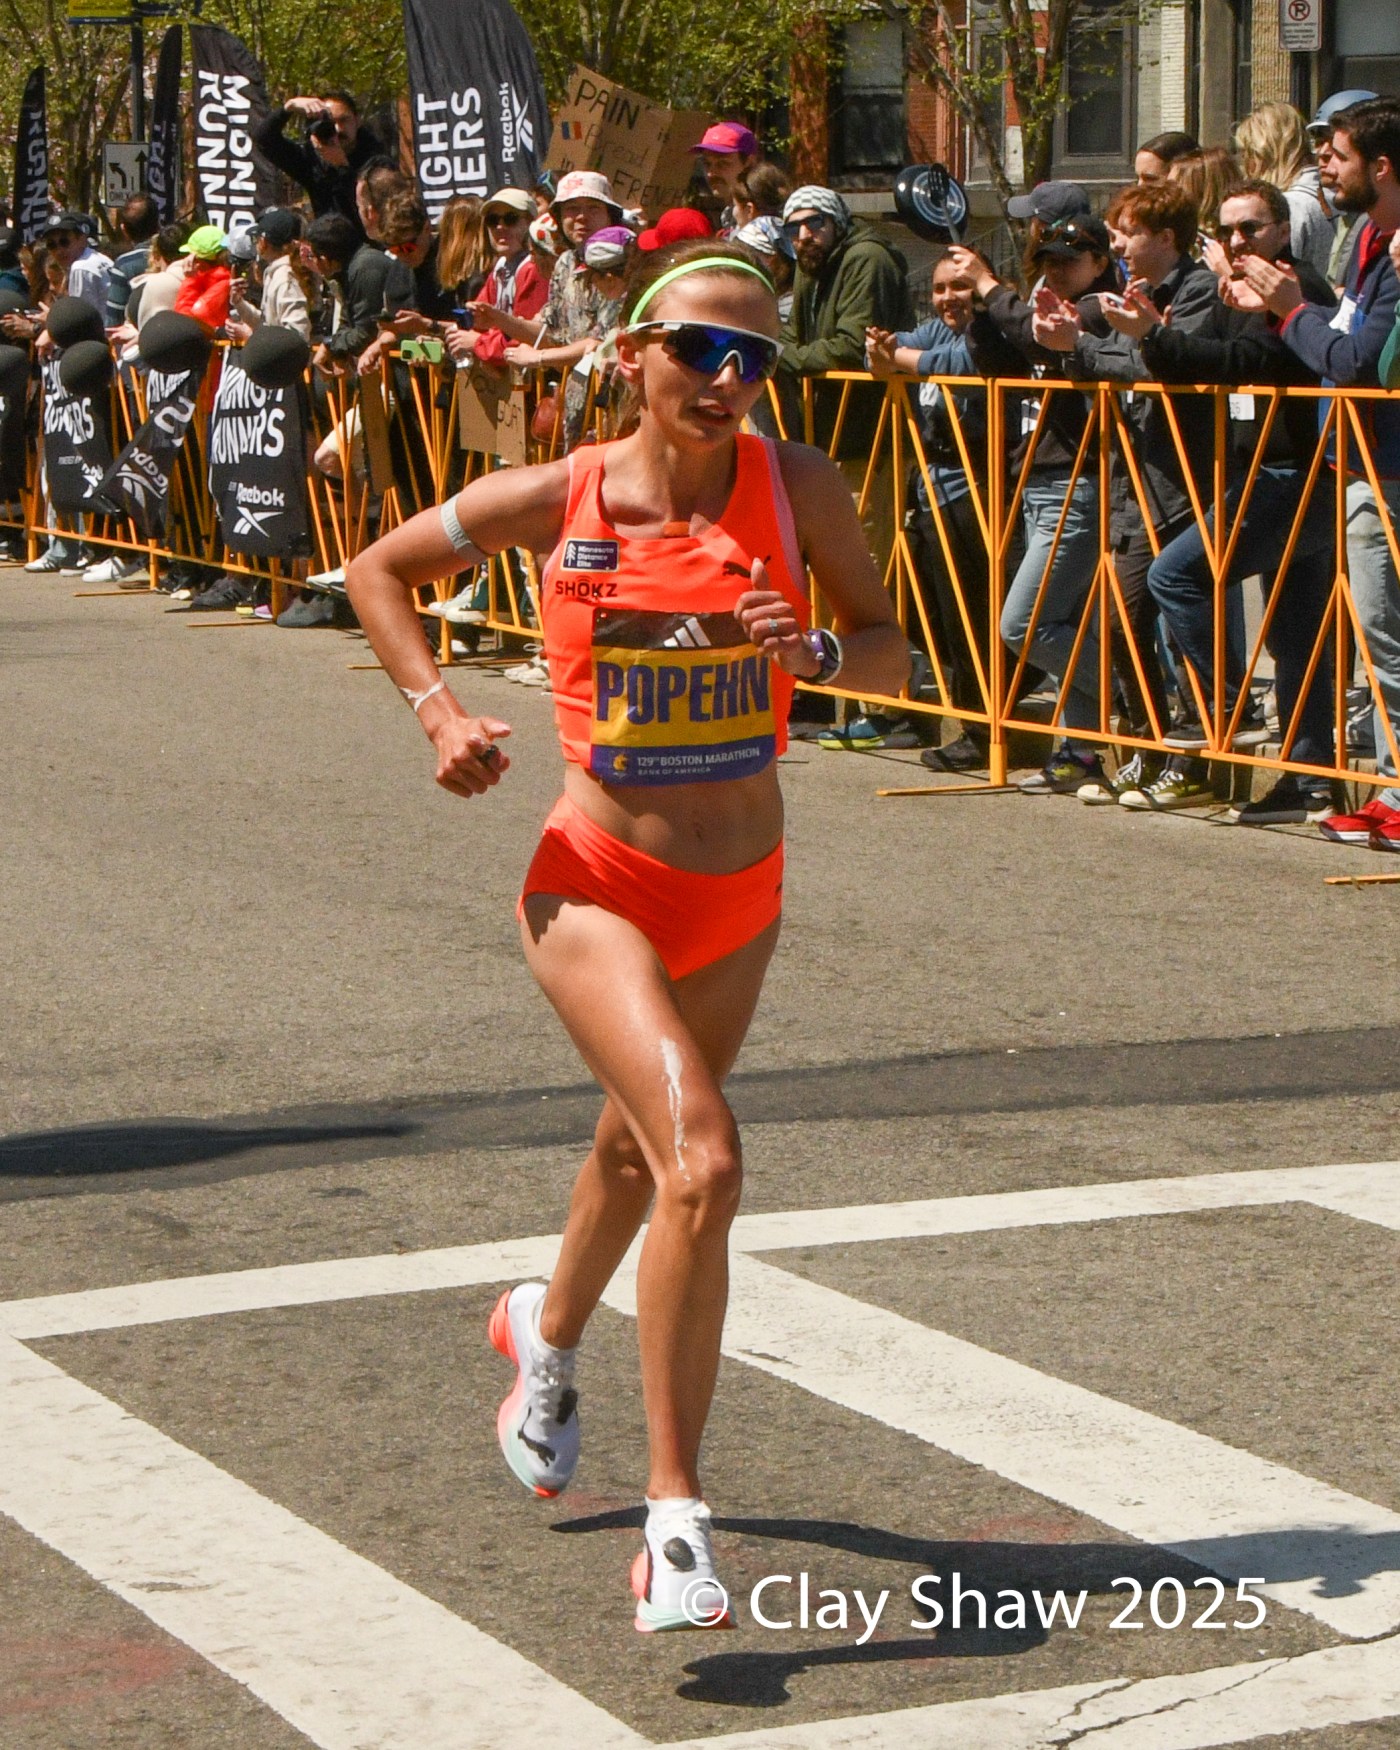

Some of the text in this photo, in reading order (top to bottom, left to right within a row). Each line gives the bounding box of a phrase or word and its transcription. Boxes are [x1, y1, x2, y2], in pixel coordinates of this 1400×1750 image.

[574, 78, 640, 131] PAIN
[499, 82, 517, 163] Reebok
[197, 70, 228, 230] RUNNE
[222, 75, 257, 233] MIDNIG
[236, 482, 286, 507] Reebok
[577, 545, 615, 554] Minnesota
[577, 552, 609, 561] Distance
[576, 560, 592, 568] Elite
[555, 580, 618, 599] SHOKZ
[596, 655, 771, 726] POPEHN
[660, 755, 703, 767] BOSTON
[705, 747, 761, 765] MARATHON
[675, 766, 712, 775] AMERICA
